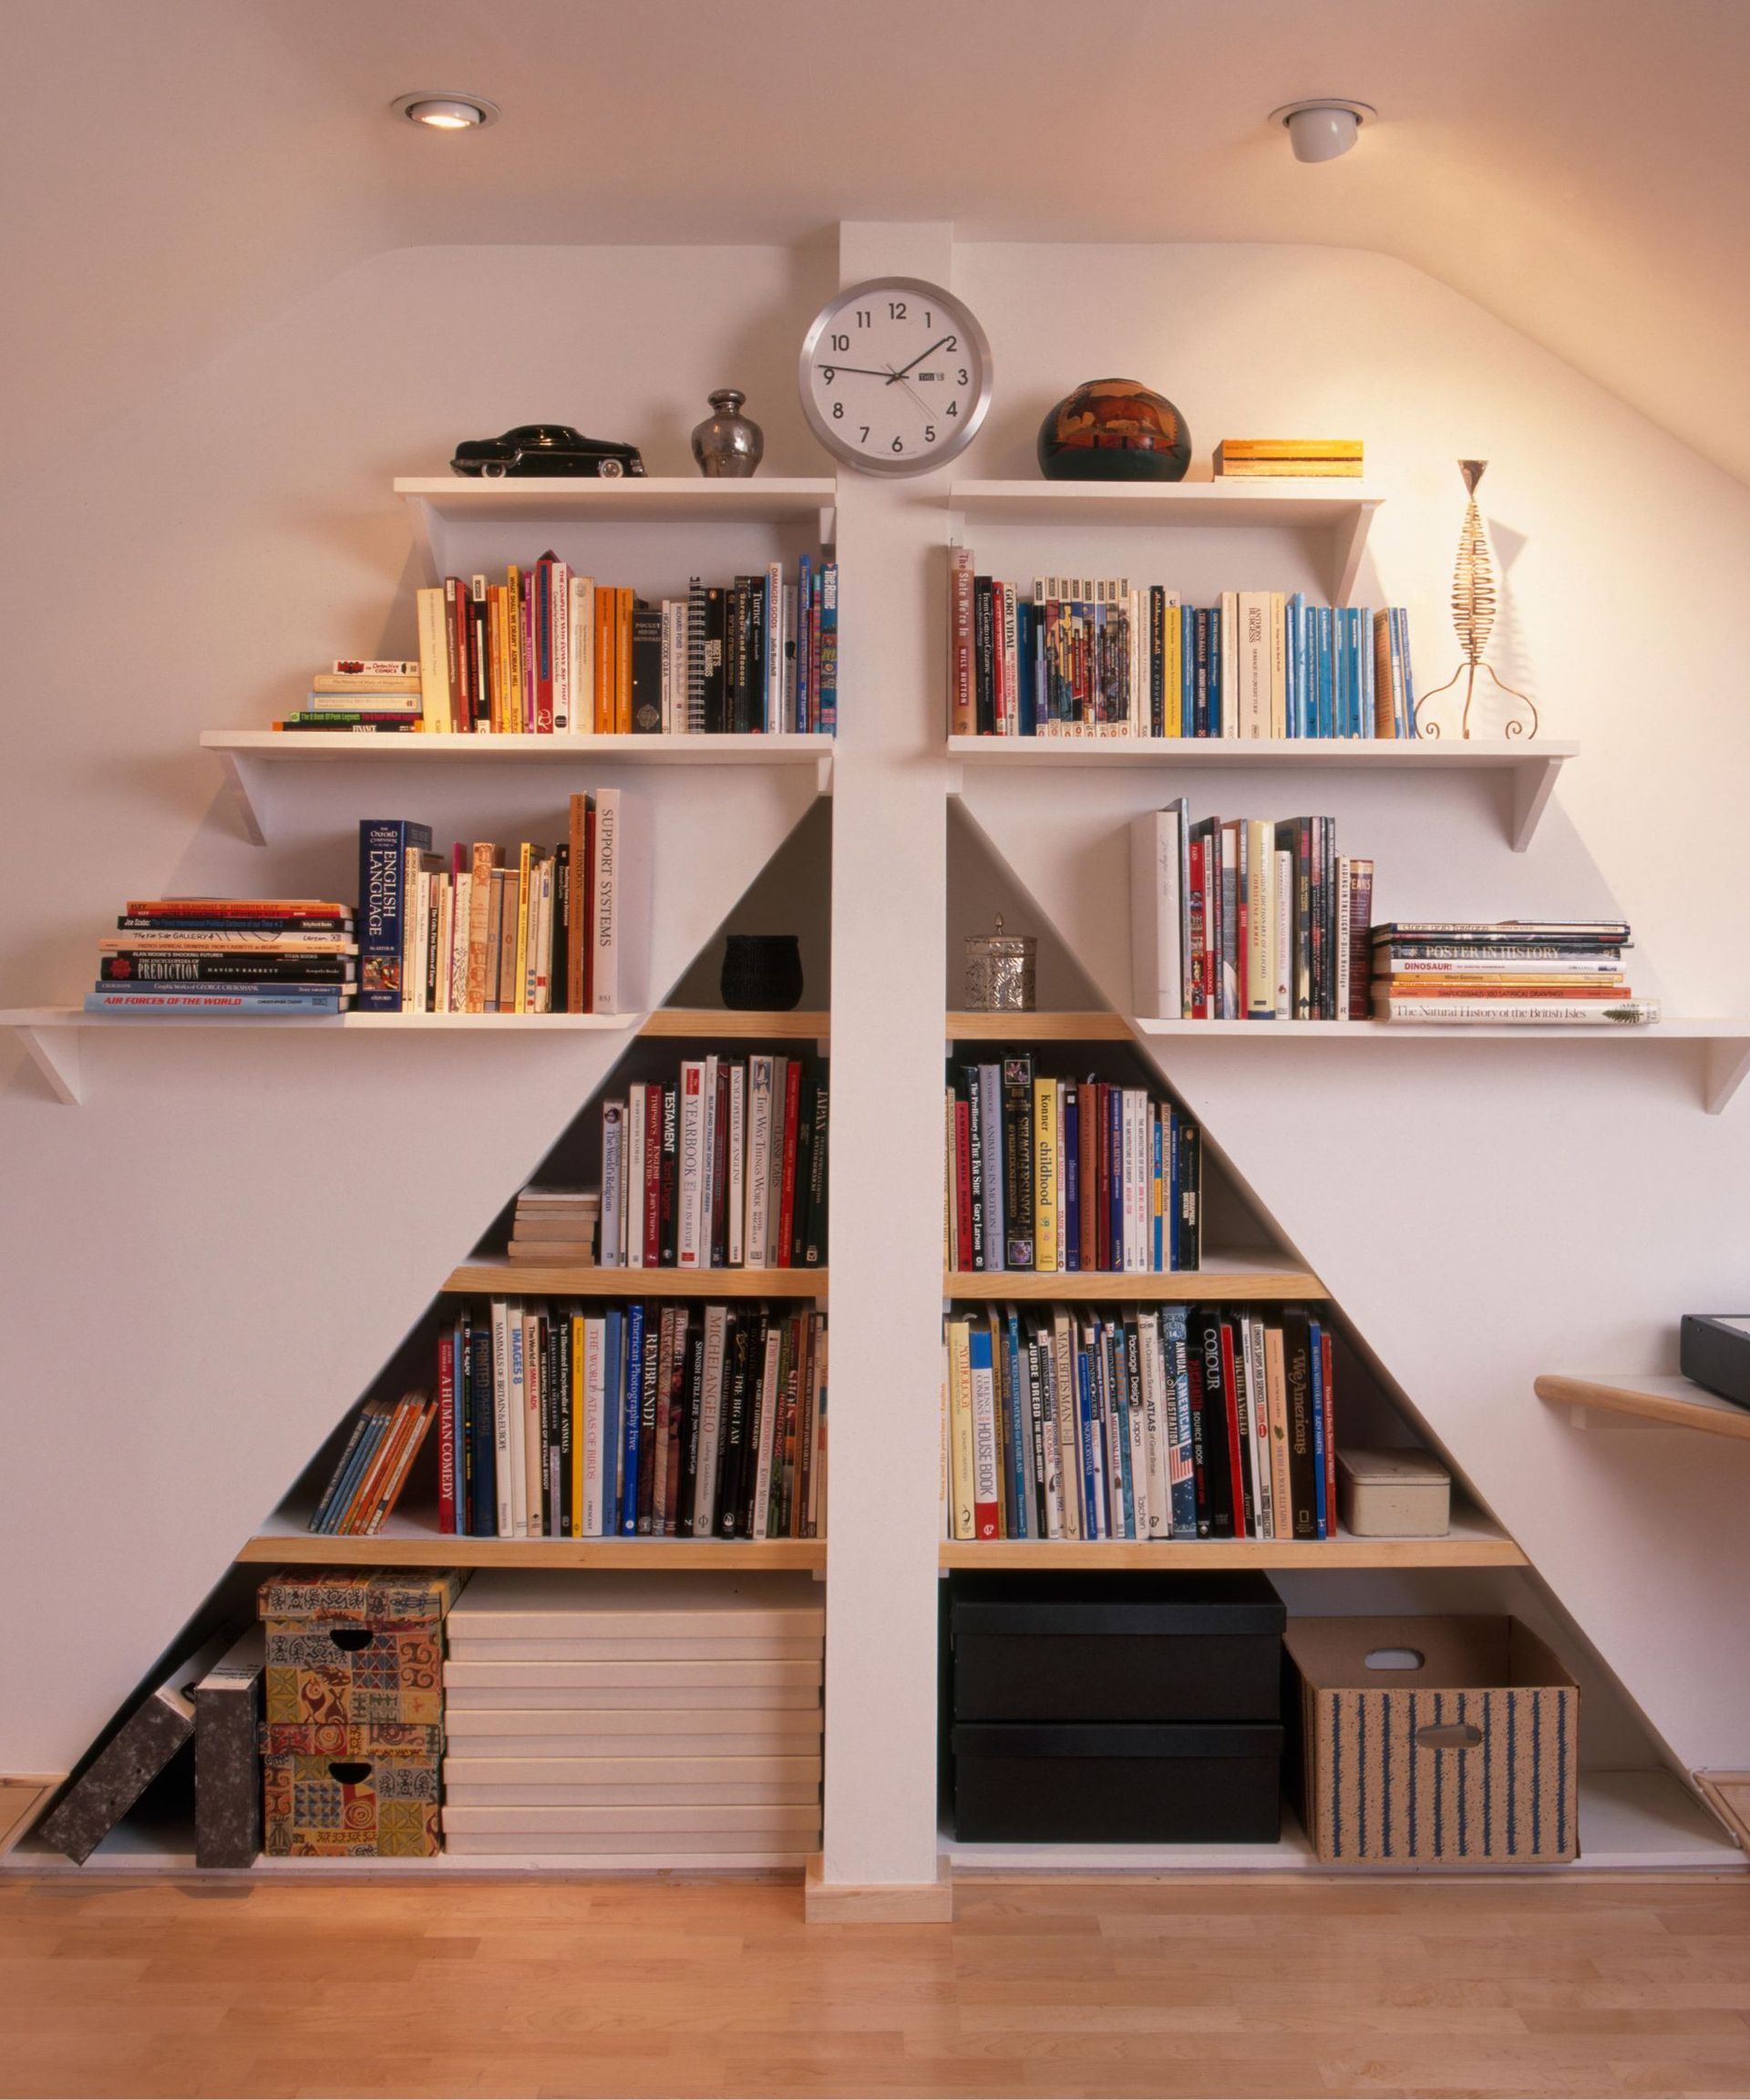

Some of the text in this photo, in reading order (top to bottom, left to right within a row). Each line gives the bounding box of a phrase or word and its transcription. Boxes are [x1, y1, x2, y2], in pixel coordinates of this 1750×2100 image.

[857, 312, 870, 328] 11
[888, 303, 907, 319] 12
[926, 312, 932, 328] 1
[831, 335, 849, 351] 10
[945, 335, 957, 352] 2
[823, 368, 835, 385] 9
[957, 369, 969, 386] 3
[832, 403, 844, 419] 8
[946, 401, 957, 417] 4
[860, 427, 870, 443] 7
[891, 437, 903, 453] 6
[924, 426, 936, 442] 5
[959, 572, 968, 596] State
[753, 591, 762, 625] Turner
[960, 627, 968, 636] In
[369, 851, 383, 936] LANGUAGE
[383, 851, 397, 917] ENGLISH
[600, 809, 614, 946] SUPPORT SYSTEMS
[139, 963, 200, 979] PREDICTION
[1426, 946, 1560, 959] POSTER IN HISTORY
[203, 998, 242, 1006] WORLD
[1395, 1006, 1586, 1020] The Natural History of the British Isles
[664, 1092, 674, 1152] TESTAMENT
[817, 1088, 828, 1131] JAPAN
[685, 1099, 698, 1177] YEARBOOK
[733, 1134, 740, 1143] OF
[753, 1094, 767, 1208] THE WAY THINGS WORK
[986, 1125, 996, 1170] ANIMALS
[1039, 1094, 1052, 1206] Konner childhood
[604, 1130, 615, 1211] The World's Religions
[773, 1163, 782, 1187] CARS
[988, 1174, 996, 1183] IN
[972, 1203, 983, 1251] Gary Larson
[988, 1188, 997, 1229] MOTION
[512, 1328, 523, 1385] IMAGES 8
[1029, 1343, 1038, 1377] JUDGE
[1127, 1334, 1138, 1373] Package
[1176, 1342, 1187, 1374] ANNUAL
[1203, 1329, 1220, 1391] COLOUR
[626, 1312, 642, 1451] American Photography Five
[643, 1334, 658, 1429] REMBRANDT
[692, 1342, 704, 1416] SPANISH STILL LIFE
[704, 1316, 722, 1434] MICHELANGELO
[961, 1343, 971, 1409] MYTHOLOGY
[1128, 1376, 1139, 1405] Design
[587, 1329, 598, 1480] THE WORLD ATLAS OF BIRDS
[1032, 1382, 1041, 1417] DREDD
[1178, 1382, 1189, 1441] AMERICAN
[1235, 1355, 1248, 1435] MICHELANGELO
[1289, 1349, 1309, 1455] We Americans
[774, 1393, 786, 1458] HAUNTED HOUSE
[1131, 1419, 1142, 1446] Japan
[1167, 1389, 1179, 1445] ILLUSTRATION
[441, 1376, 453, 1500] A HUMAN COMEDY
[978, 1422, 993, 1495] HOUSE BOOK
[1035, 1434, 1044, 1483] MEGA-HISTORY
[1137, 1496, 1147, 1529] Taschen
